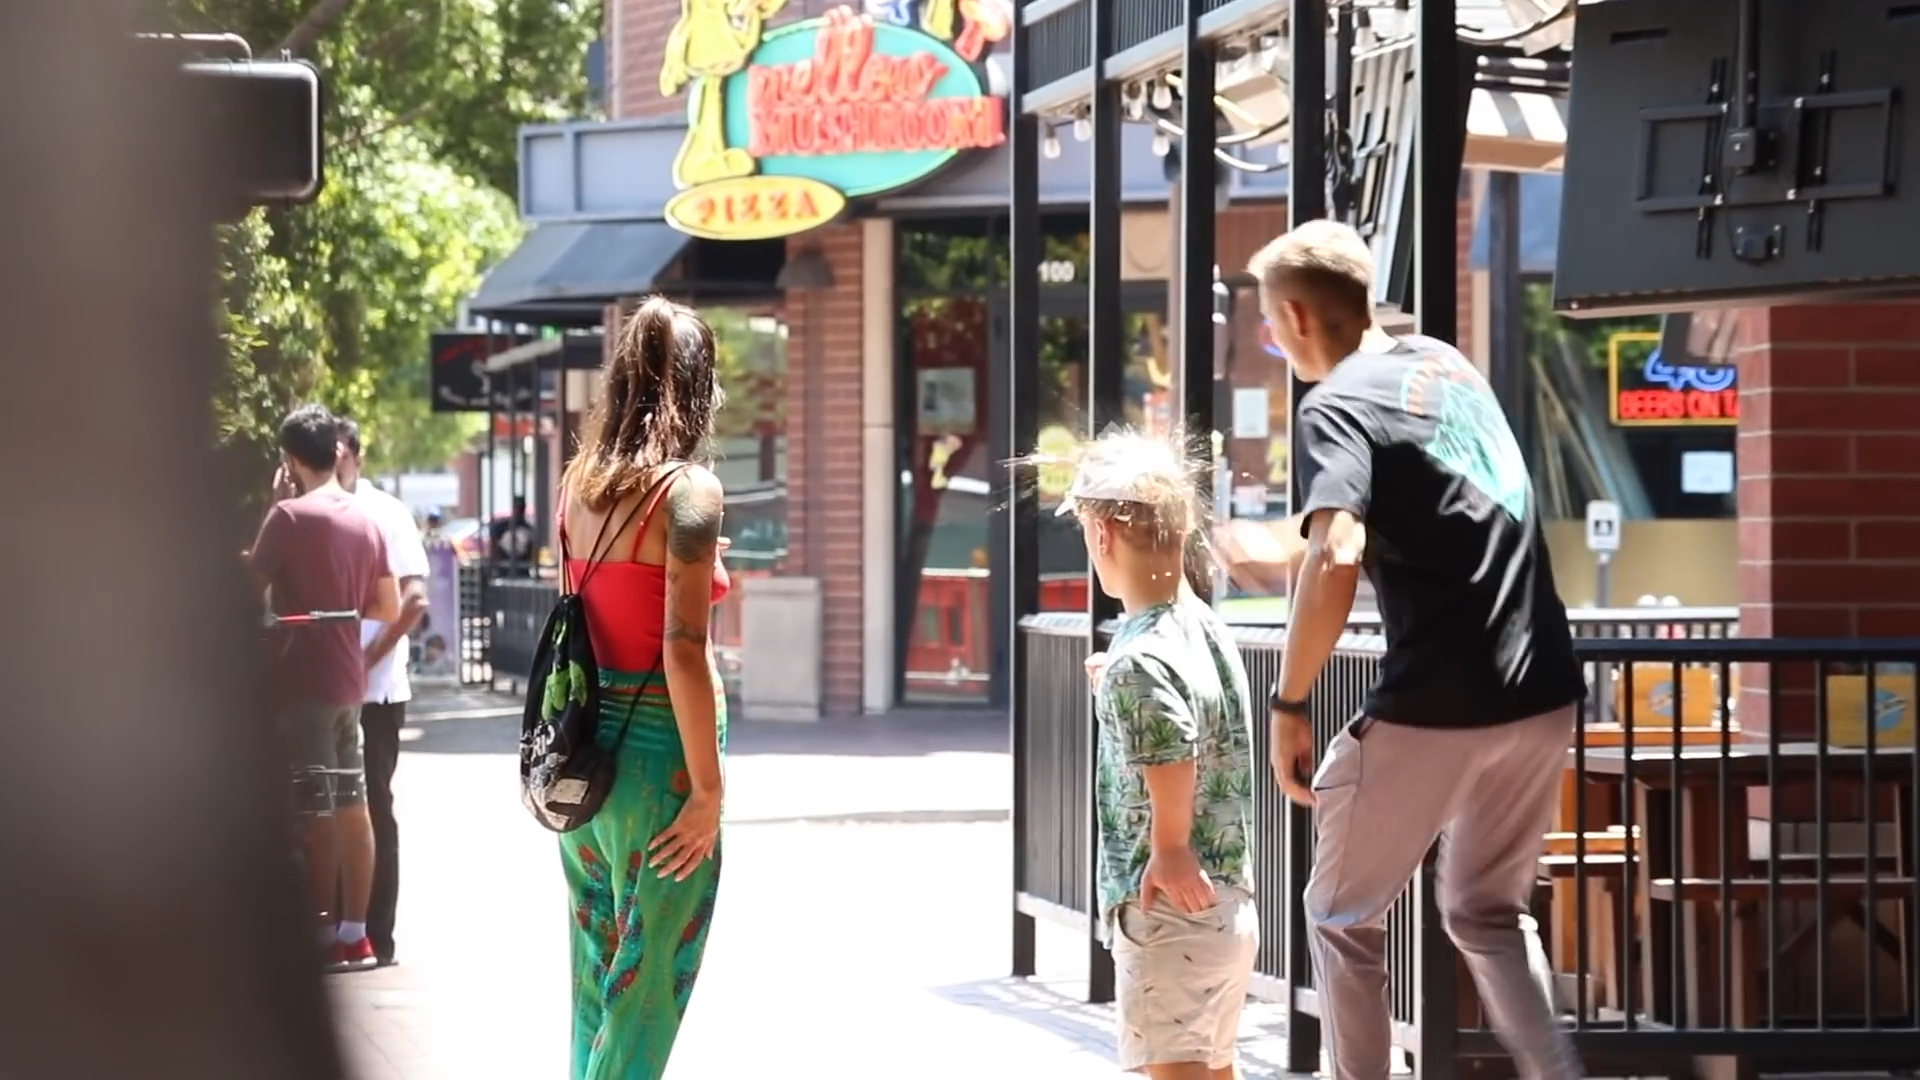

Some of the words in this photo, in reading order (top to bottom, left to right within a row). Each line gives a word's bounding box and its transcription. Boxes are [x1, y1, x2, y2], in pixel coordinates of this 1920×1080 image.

[747, 96, 1005, 158] MUSHROOM
[695, 190, 821, 224] PIZZA
[1037, 260, 1075, 282] 100
[1620, 390, 1685, 419] BEERS
